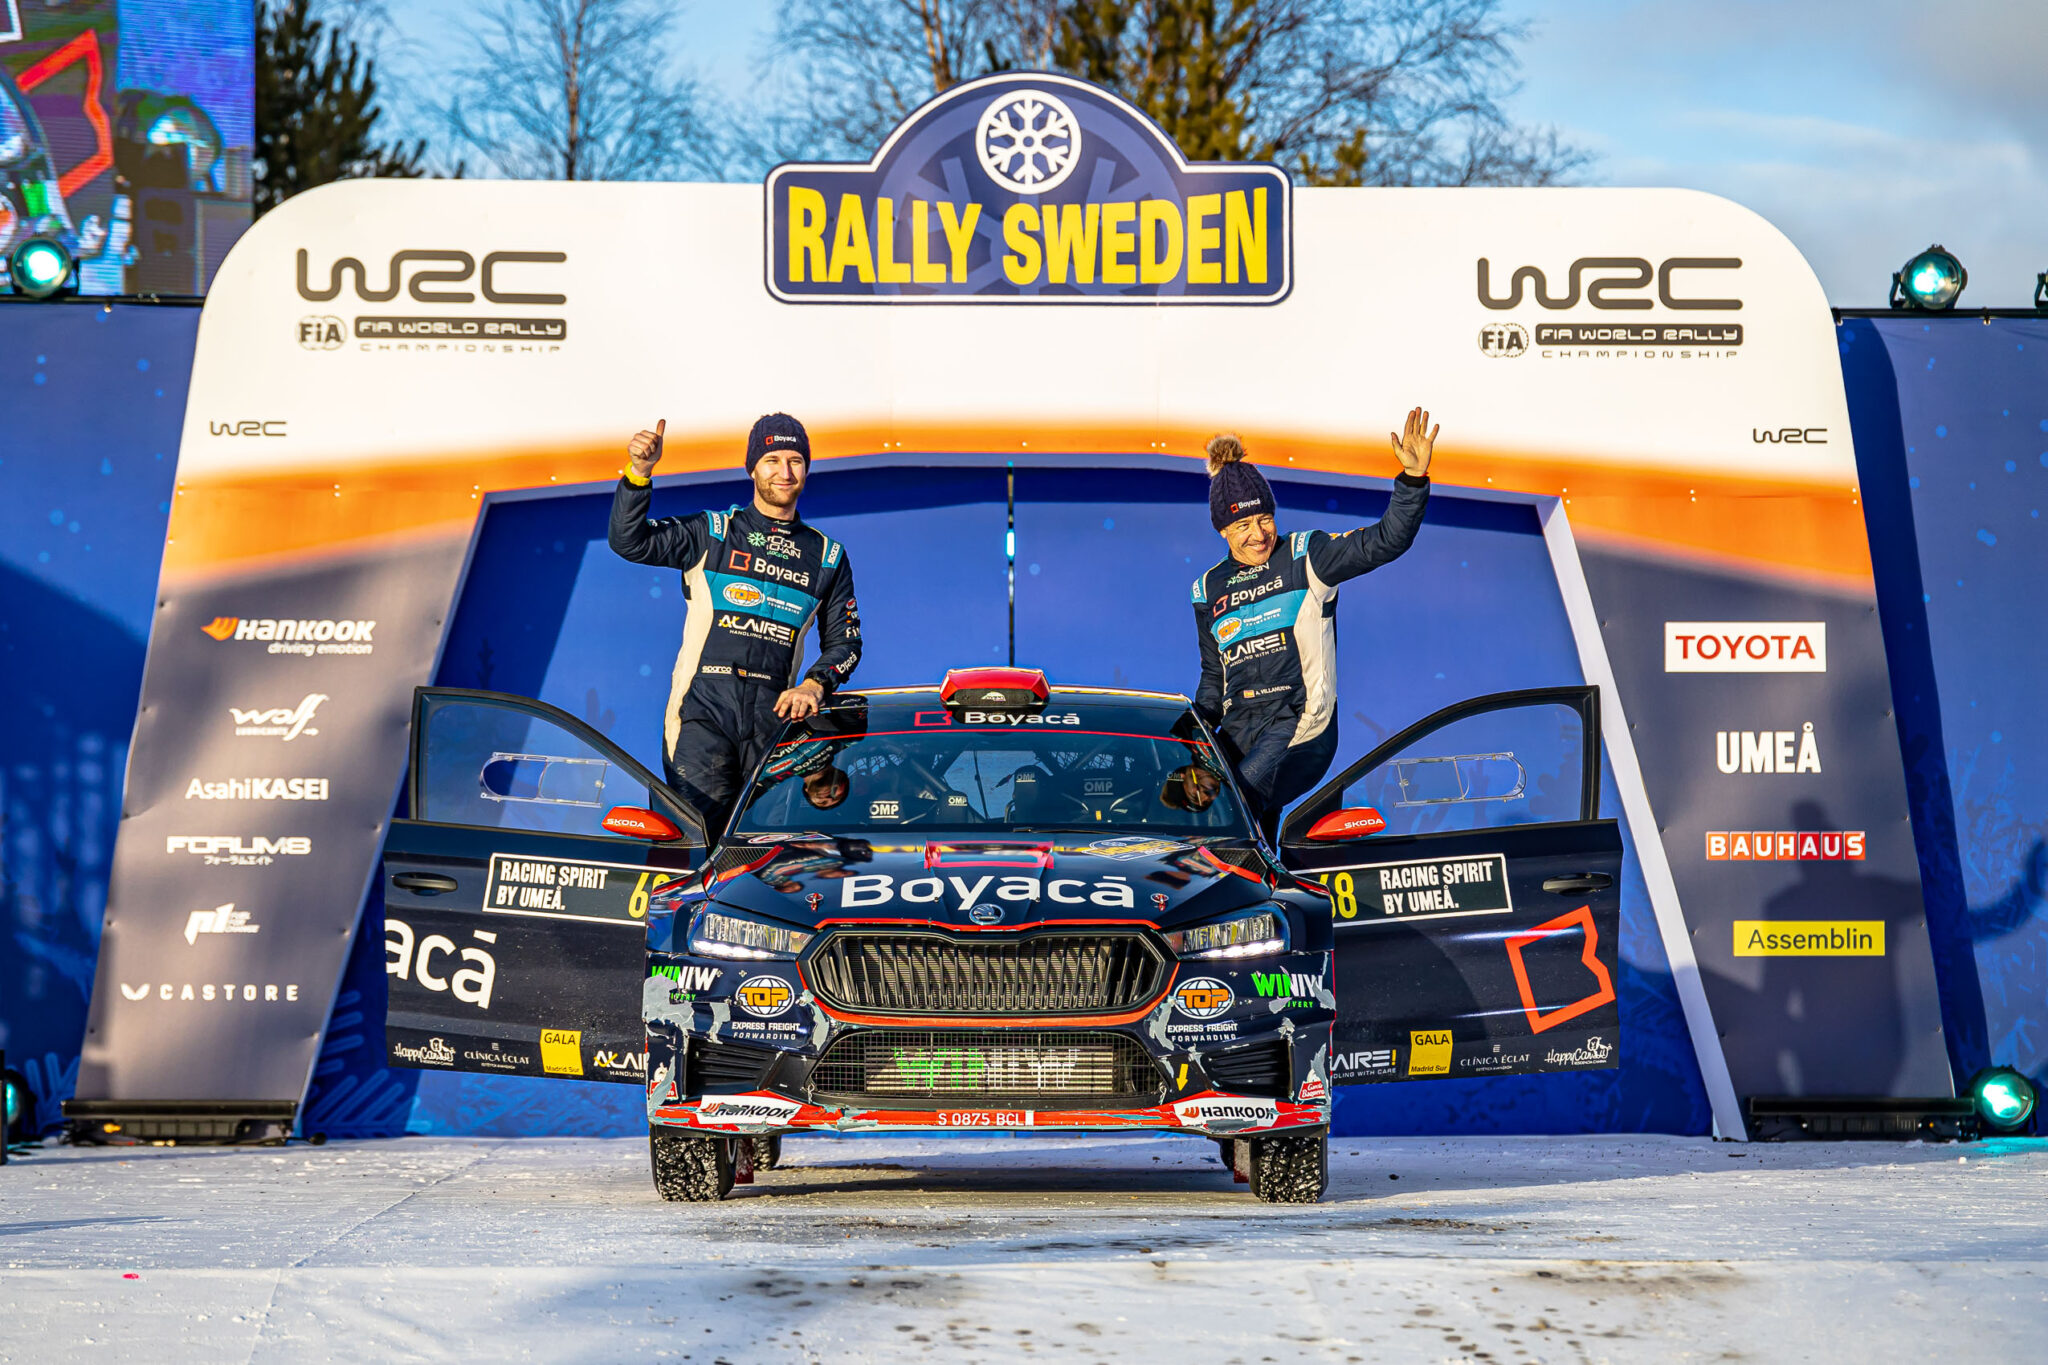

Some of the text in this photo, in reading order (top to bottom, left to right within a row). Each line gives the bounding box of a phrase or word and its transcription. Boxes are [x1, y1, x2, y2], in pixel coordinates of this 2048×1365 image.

[788, 186, 1268, 284] RALLY SWEDEN
[297, 248, 567, 304] WRC
[1477, 257, 1743, 310] WRC
[359, 321, 562, 336] FIA WORLD RALLY
[1540, 328, 1738, 341] FIA WORLD RALLY
[360, 343, 560, 353] CHAMPIONSHIP
[1542, 350, 1738, 359] CHAMPIONSHIP
[210, 420, 287, 437] WRC
[1753, 427, 1828, 444] WRC
[727, 587, 760, 602] TOP
[1675, 635, 1816, 660] TOYOTA
[1716, 721, 1821, 774] UMEÅ
[1084, 781, 1113, 793] OMP
[948, 796, 968, 805] OMP
[869, 803, 899, 816] OMP
[166, 835, 312, 854] FORUM8
[1709, 835, 1864, 857] BAUHAUS
[500, 860, 608, 889] RACING SPIRIT
[1379, 861, 1493, 890] RACING SPIRIT
[495, 885, 566, 911] BY UMEÅ.
[1382, 884, 1460, 915] BY UMEÅ.
[1748, 928, 1873, 949] Assemblin
[160, 984, 299, 1001] CASTORE
[740, 987, 789, 1006] TOP
[1178, 988, 1229, 1008] TOP
[732, 1022, 800, 1031] EXPRESS FREIGHT
[1167, 1023, 1238, 1033] EXPRESS FREIGHT
[544, 1032, 576, 1045] GALA
[733, 1032, 796, 1040] FORWARDING
[1171, 1033, 1236, 1042] FORWARDING
[1414, 1033, 1450, 1046] GALA
[546, 1065, 567, 1073] Madrid
[609, 1070, 645, 1078] HANDLING
[1332, 1071, 1355, 1079] DLING
[1411, 1065, 1434, 1073] Madrid
[938, 1113, 1024, 1126] S 0875 BCL
